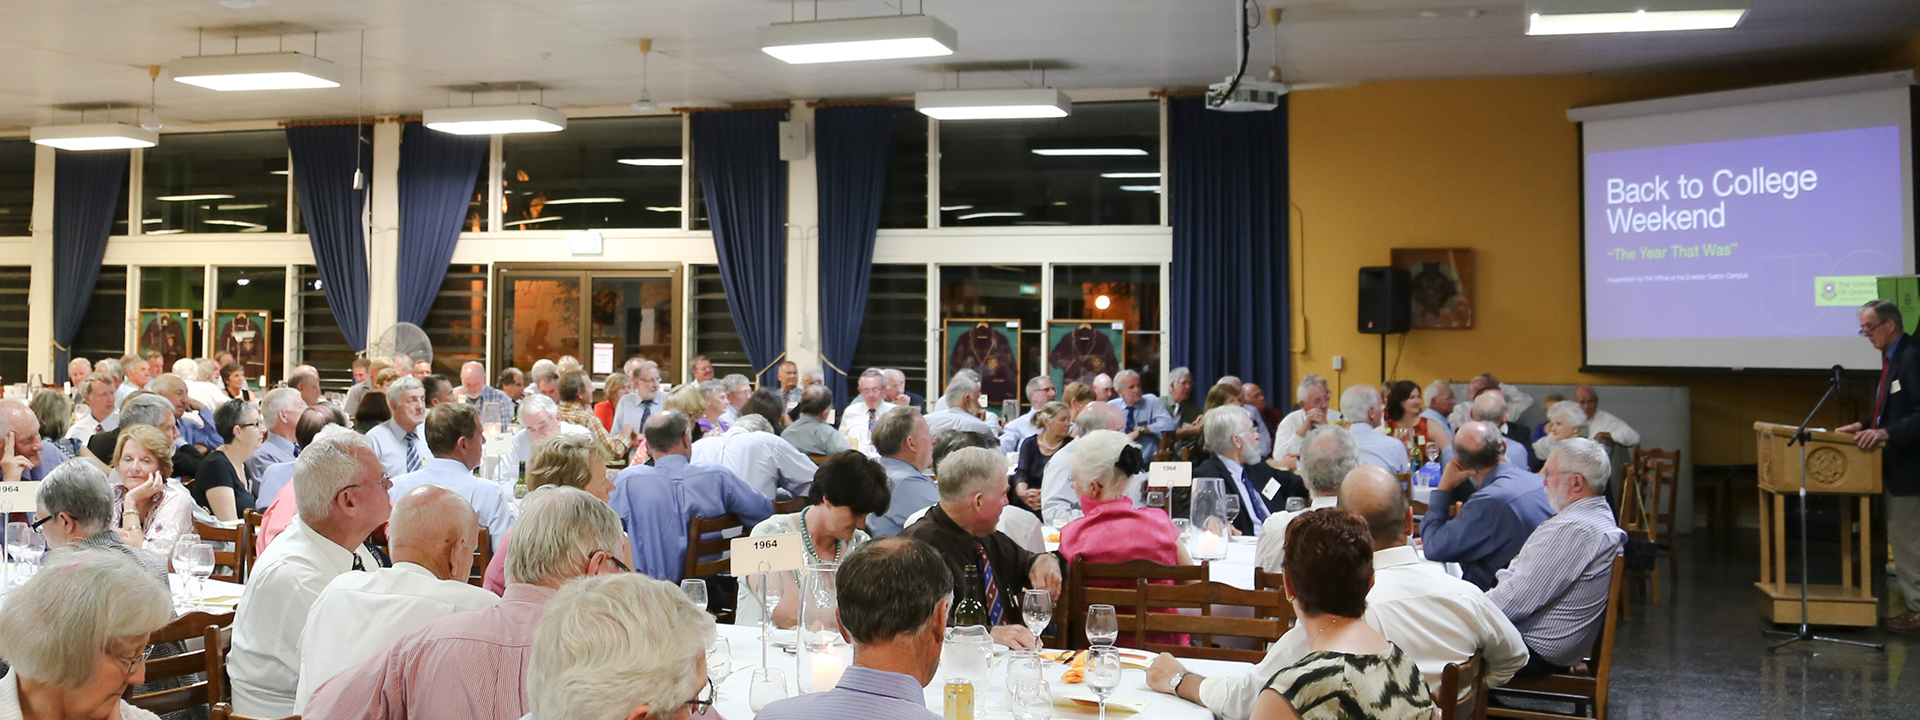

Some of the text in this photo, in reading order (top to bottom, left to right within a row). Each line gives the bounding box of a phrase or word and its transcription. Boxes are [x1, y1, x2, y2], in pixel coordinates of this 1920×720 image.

[1606, 166, 1818, 205] Back to College
[1606, 201, 1726, 234] Weekend
[1639, 245, 1668, 259] Year
[1670, 244, 1700, 258] That
[754, 539, 778, 550] 1964
